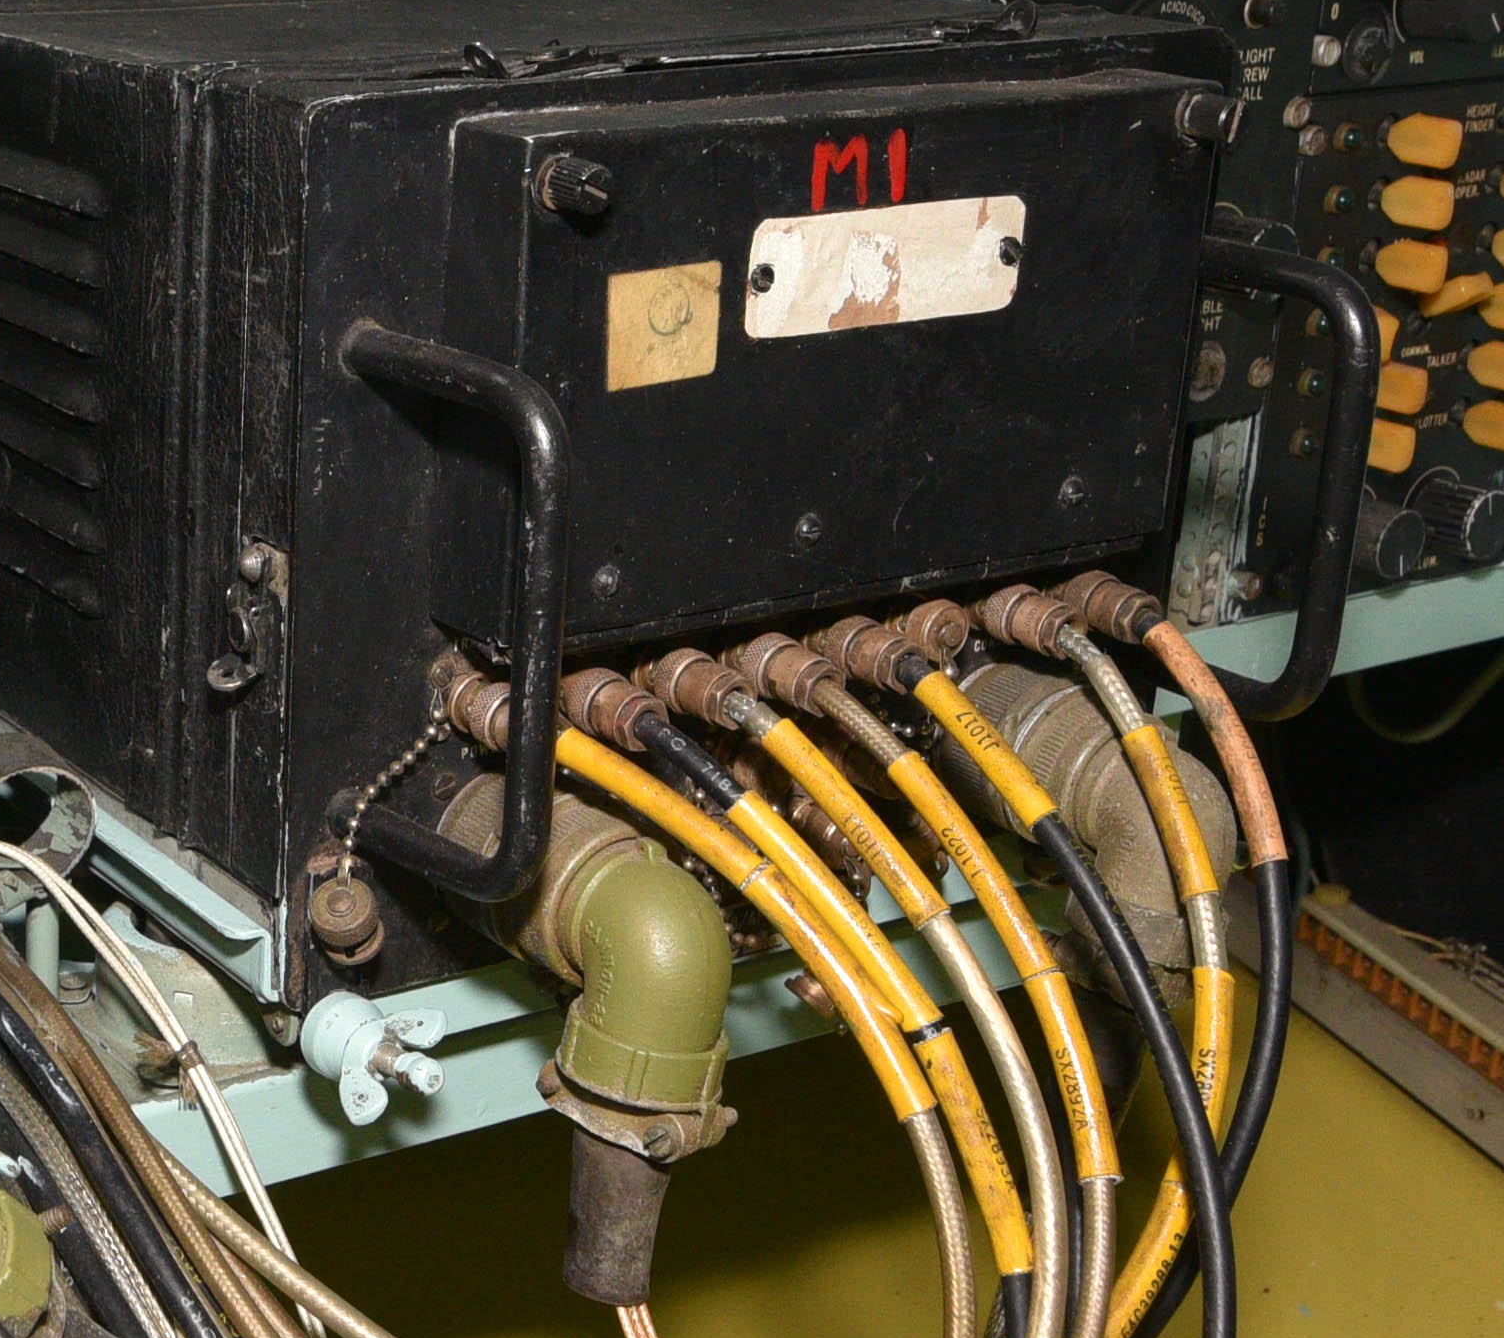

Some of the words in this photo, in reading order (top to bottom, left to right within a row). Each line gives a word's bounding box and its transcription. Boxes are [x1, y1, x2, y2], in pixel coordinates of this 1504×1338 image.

[1238, 47, 1276, 63] LIGHT
[1242, 67, 1269, 83] REW
[1466, 103, 1497, 116] HEIGHT
